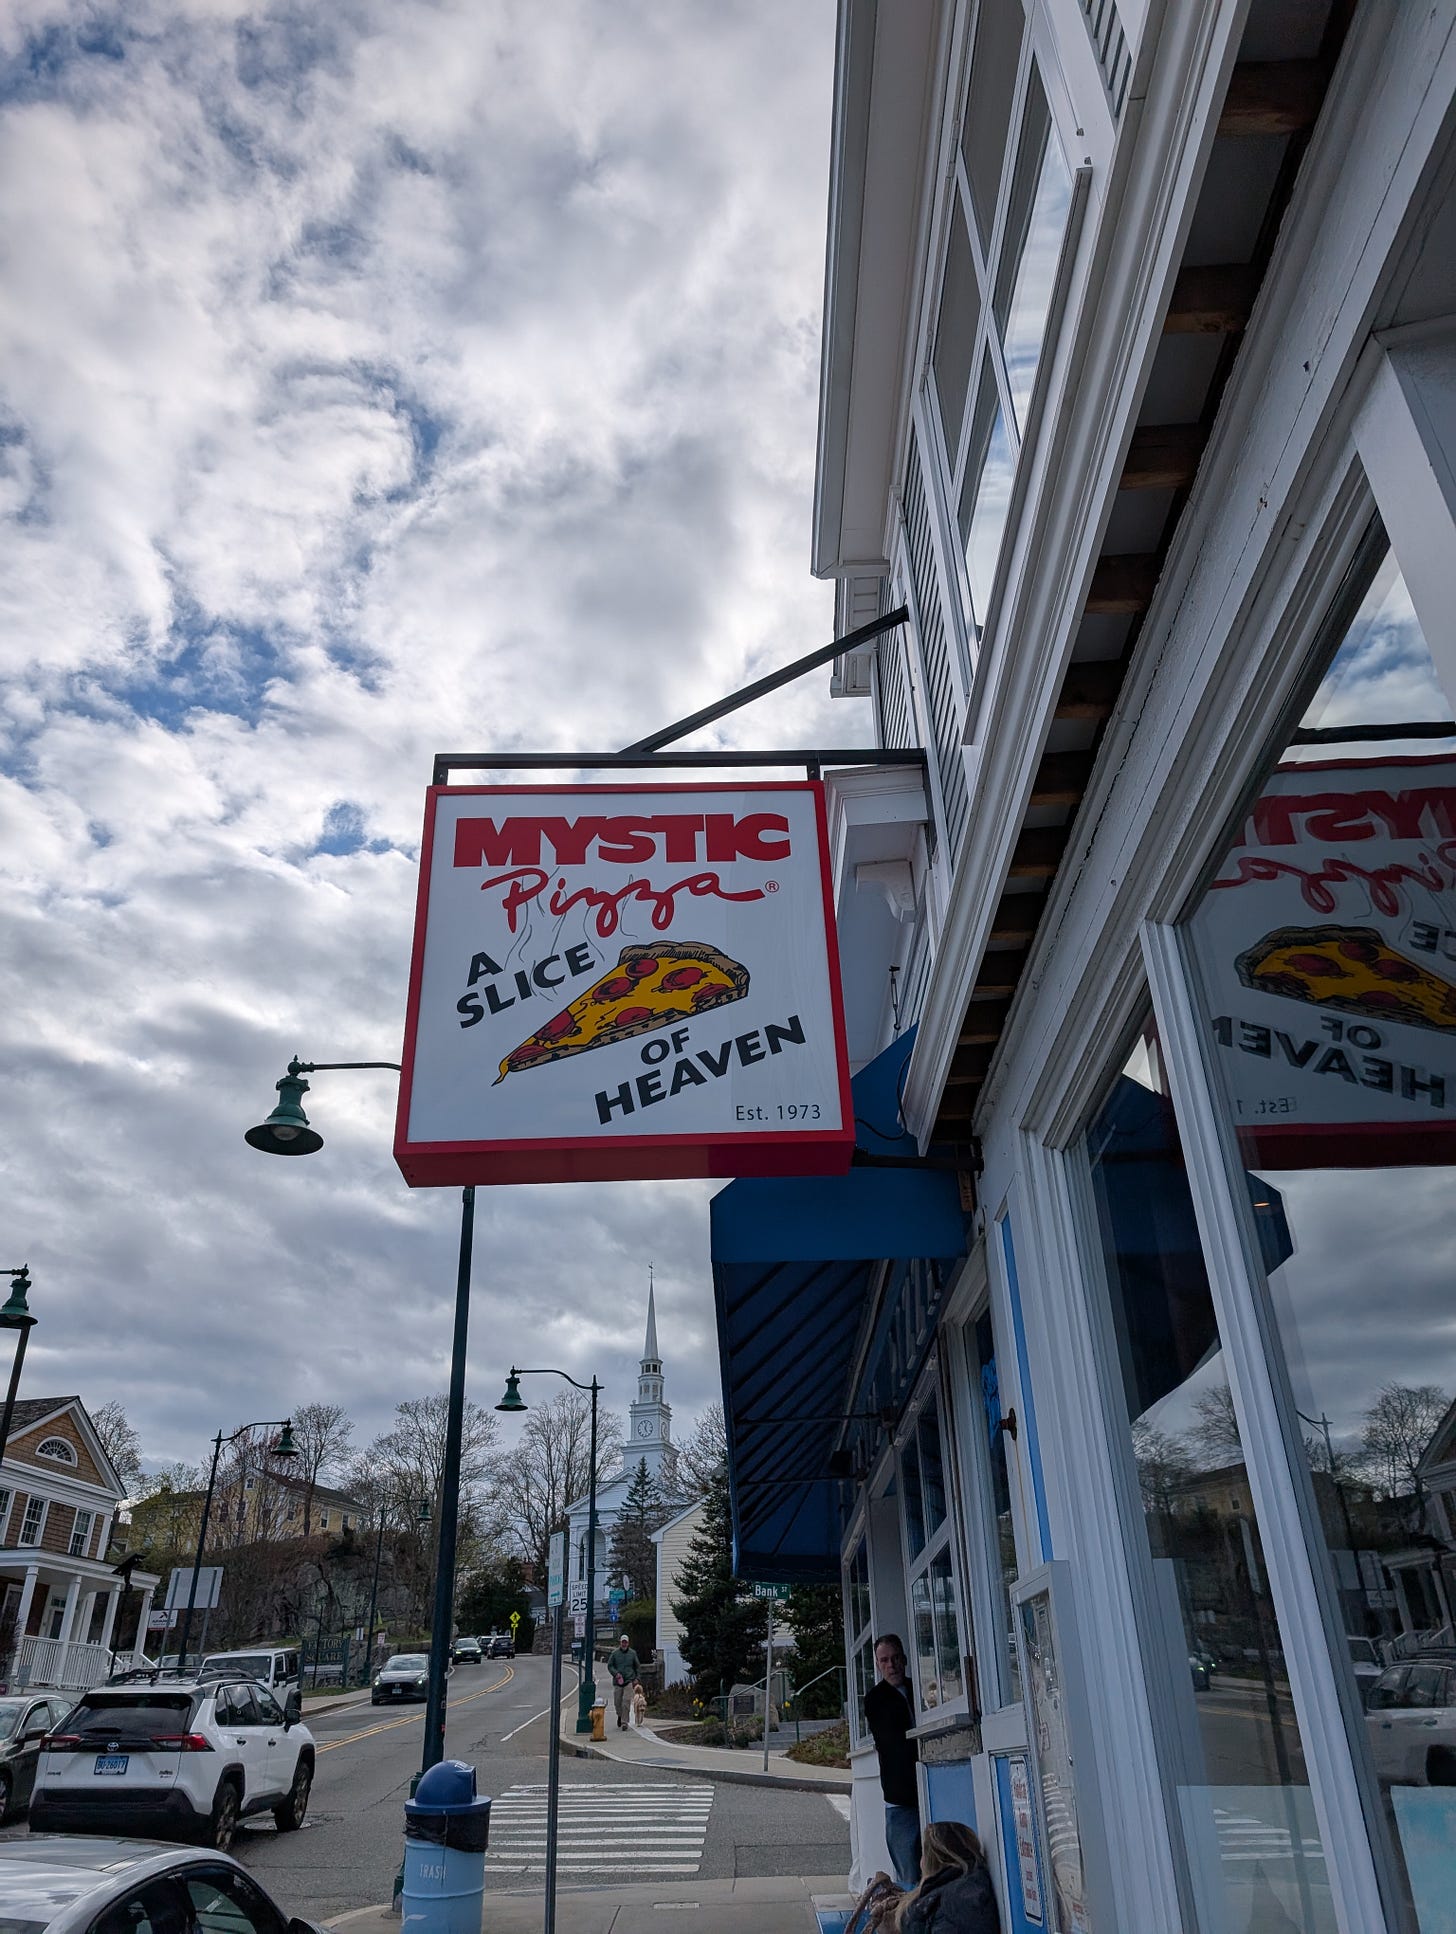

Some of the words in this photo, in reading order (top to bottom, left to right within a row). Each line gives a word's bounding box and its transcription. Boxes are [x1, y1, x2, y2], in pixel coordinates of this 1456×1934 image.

[453, 813, 791, 868] MYSTIC
[467, 951, 503, 987] A
[456, 942, 596, 1029] SLICE
[640, 1027, 690, 1066] OF
[594, 1015, 806, 1124] HEAVEN
[736, 1105, 769, 1121] Est.
[776, 1103, 821, 1121] 1973
[571, 1598, 588, 1611] 25
[572, 1590, 587, 1598] LIMIT
[755, 1585, 778, 1597] Bank
[420, 1864, 447, 1880] TRASH
